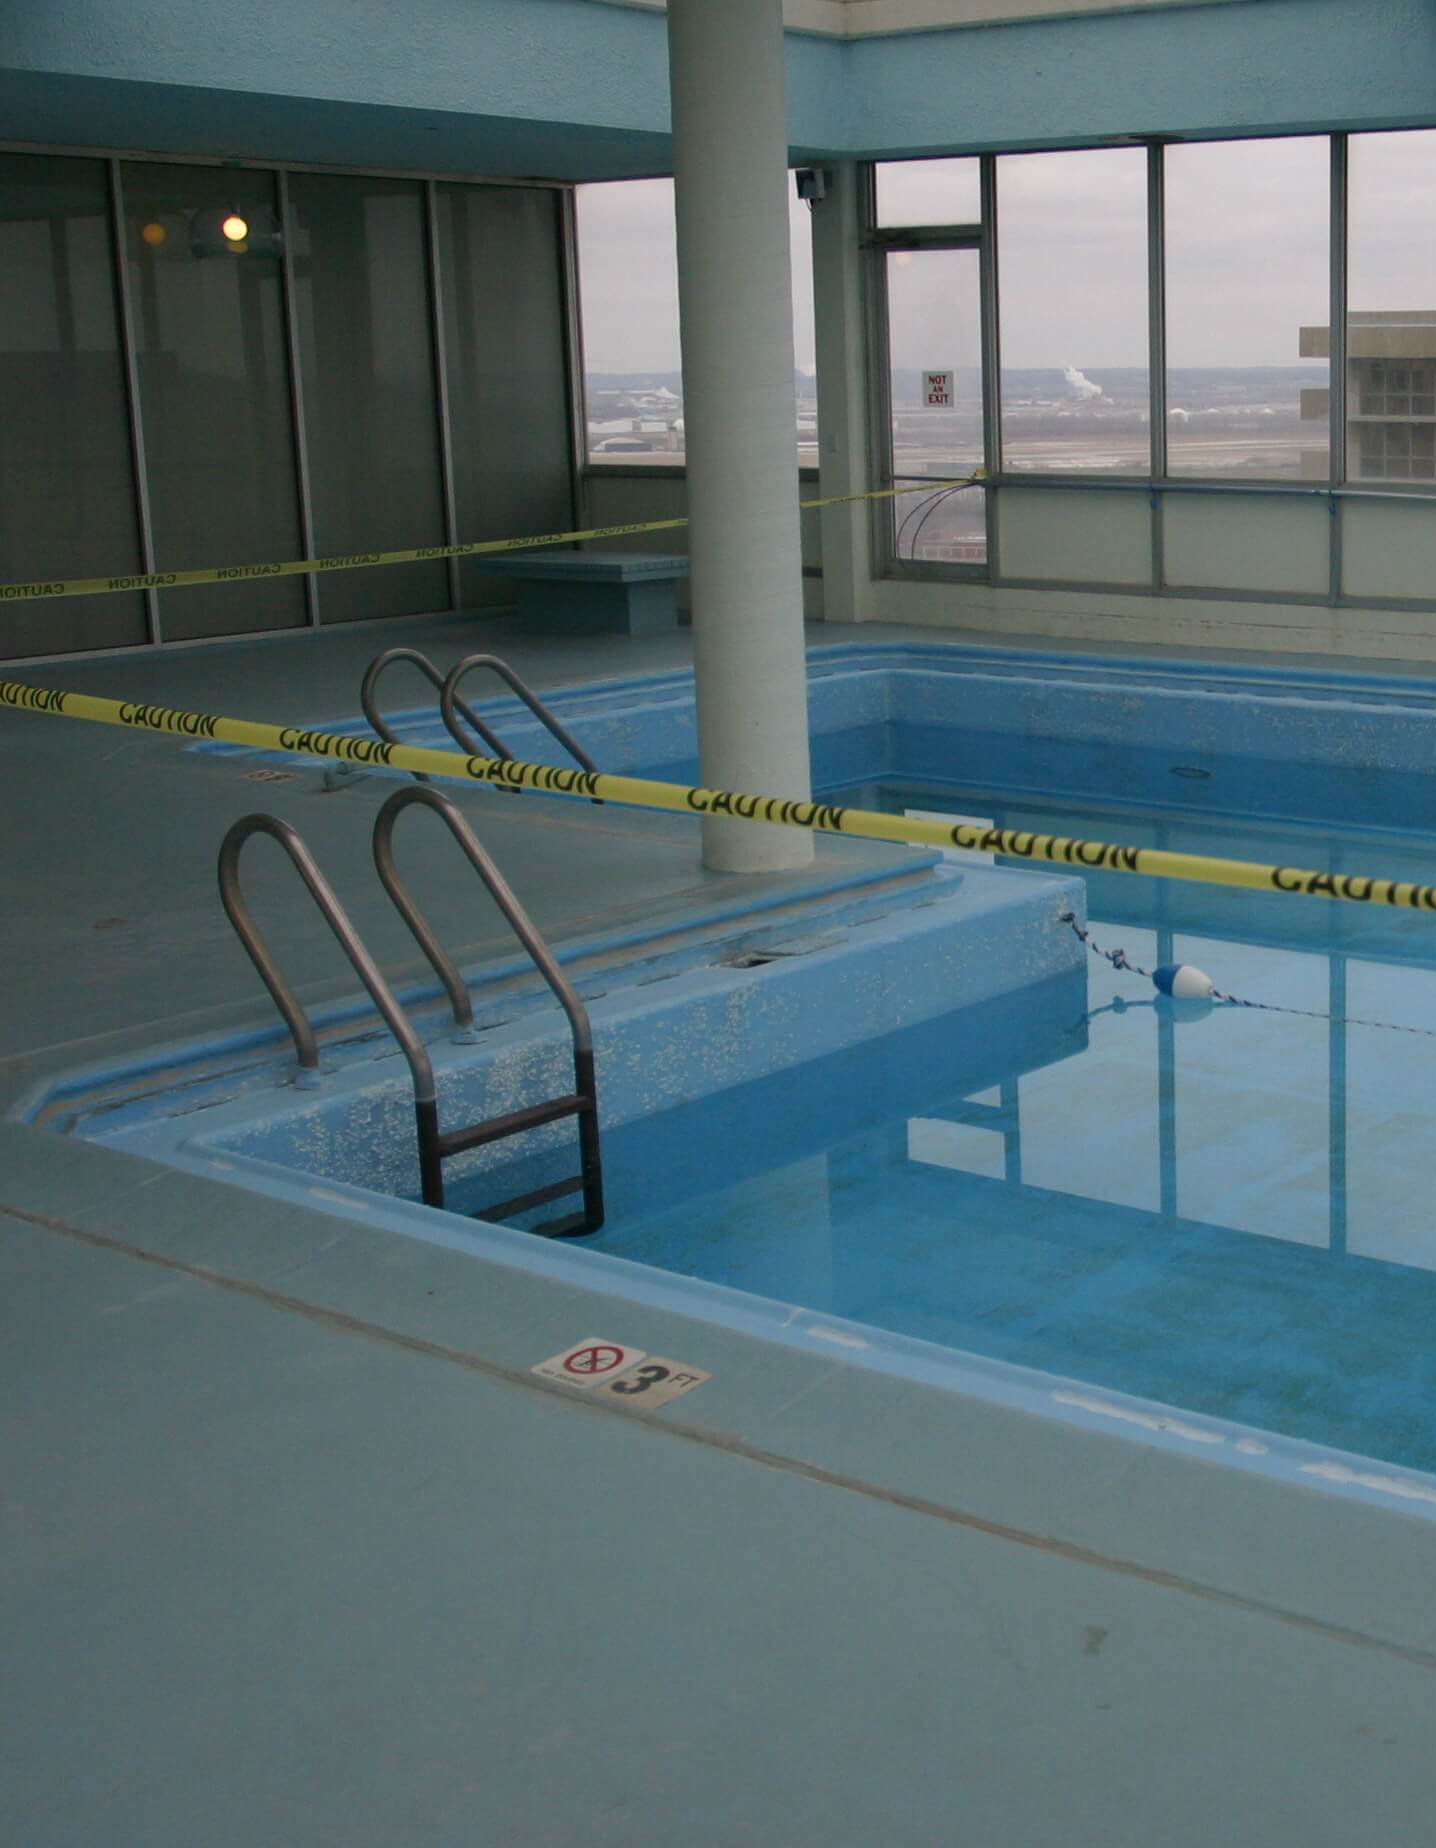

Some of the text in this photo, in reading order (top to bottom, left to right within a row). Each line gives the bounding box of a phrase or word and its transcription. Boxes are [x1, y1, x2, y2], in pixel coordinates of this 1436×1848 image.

[928, 375, 947, 384] NOT
[933, 385, 943, 393] AN
[928, 394, 949, 404] EXIT
[119, 702, 219, 738] CAUTION
[279, 728, 397, 765] CAUTION
[466, 755, 601, 795] CAUTION
[687, 787, 845, 830] CAUTION
[951, 824, 1143, 871] CAUTION
[611, 1365, 671, 1394] 3
[667, 1372, 701, 1388] FT
